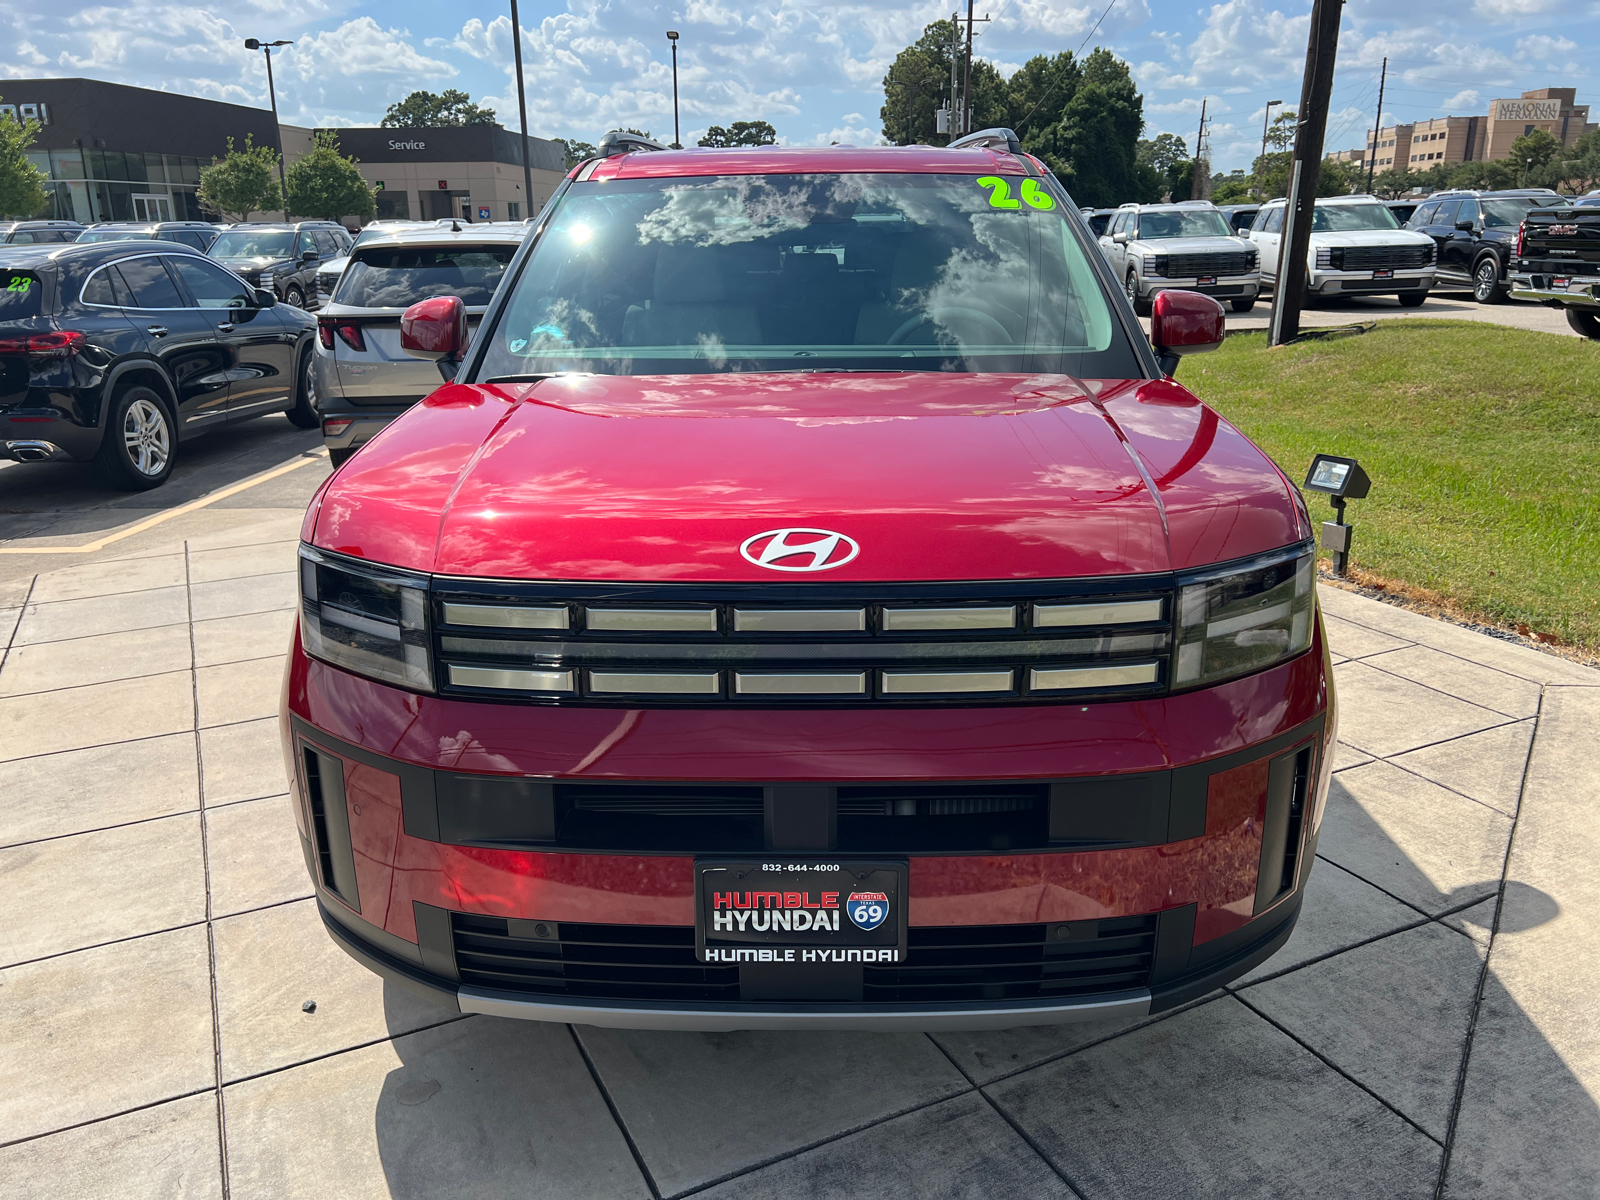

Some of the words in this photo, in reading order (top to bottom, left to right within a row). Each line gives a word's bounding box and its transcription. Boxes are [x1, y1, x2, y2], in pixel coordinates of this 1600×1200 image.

[1501, 102, 1558, 112] MEMORIAL
[1500, 110, 1556, 120] HERMANN
[388, 139, 426, 150] Service
[976, 176, 1057, 211] 26
[7, 276, 32, 293] 23
[762, 863, 840, 872] 832-644-4000
[713, 891, 840, 909] HUMBLE
[713, 910, 840, 932] HYUNDAI
[854, 905, 882, 923] 69
[705, 949, 795, 962] HUMBLE
[802, 949, 898, 962] HYUNDAI
